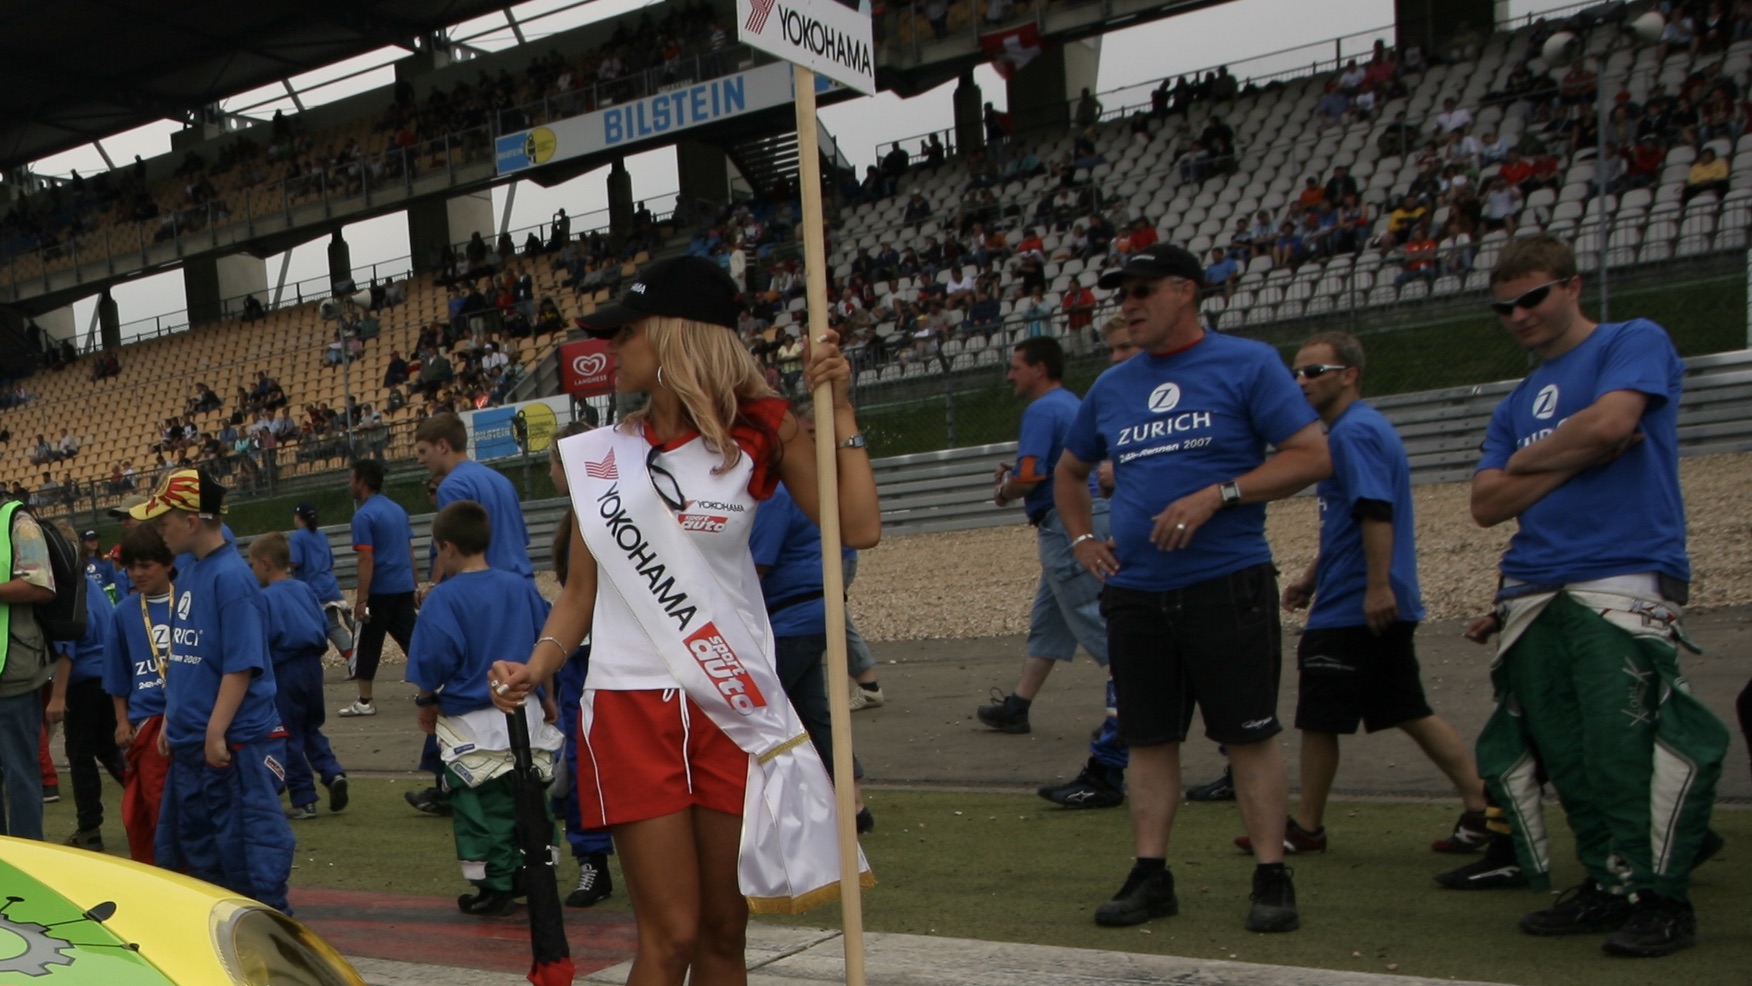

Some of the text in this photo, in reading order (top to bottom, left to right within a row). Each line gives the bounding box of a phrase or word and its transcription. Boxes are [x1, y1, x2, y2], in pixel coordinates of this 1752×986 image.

[777, 4, 873, 78] YOKOHAMA
[603, 75, 746, 145] BILSTEIN
[574, 375, 608, 386] LANGNESE
[1116, 411, 1212, 446] ZURICH
[1183, 436, 1213, 450] 2007
[697, 500, 745, 512] YOKOHAMA
[681, 519, 727, 533] auto
[596, 481, 698, 632] YOKOHAMA
[709, 635, 746, 676] sport
[689, 638, 754, 716] auto
